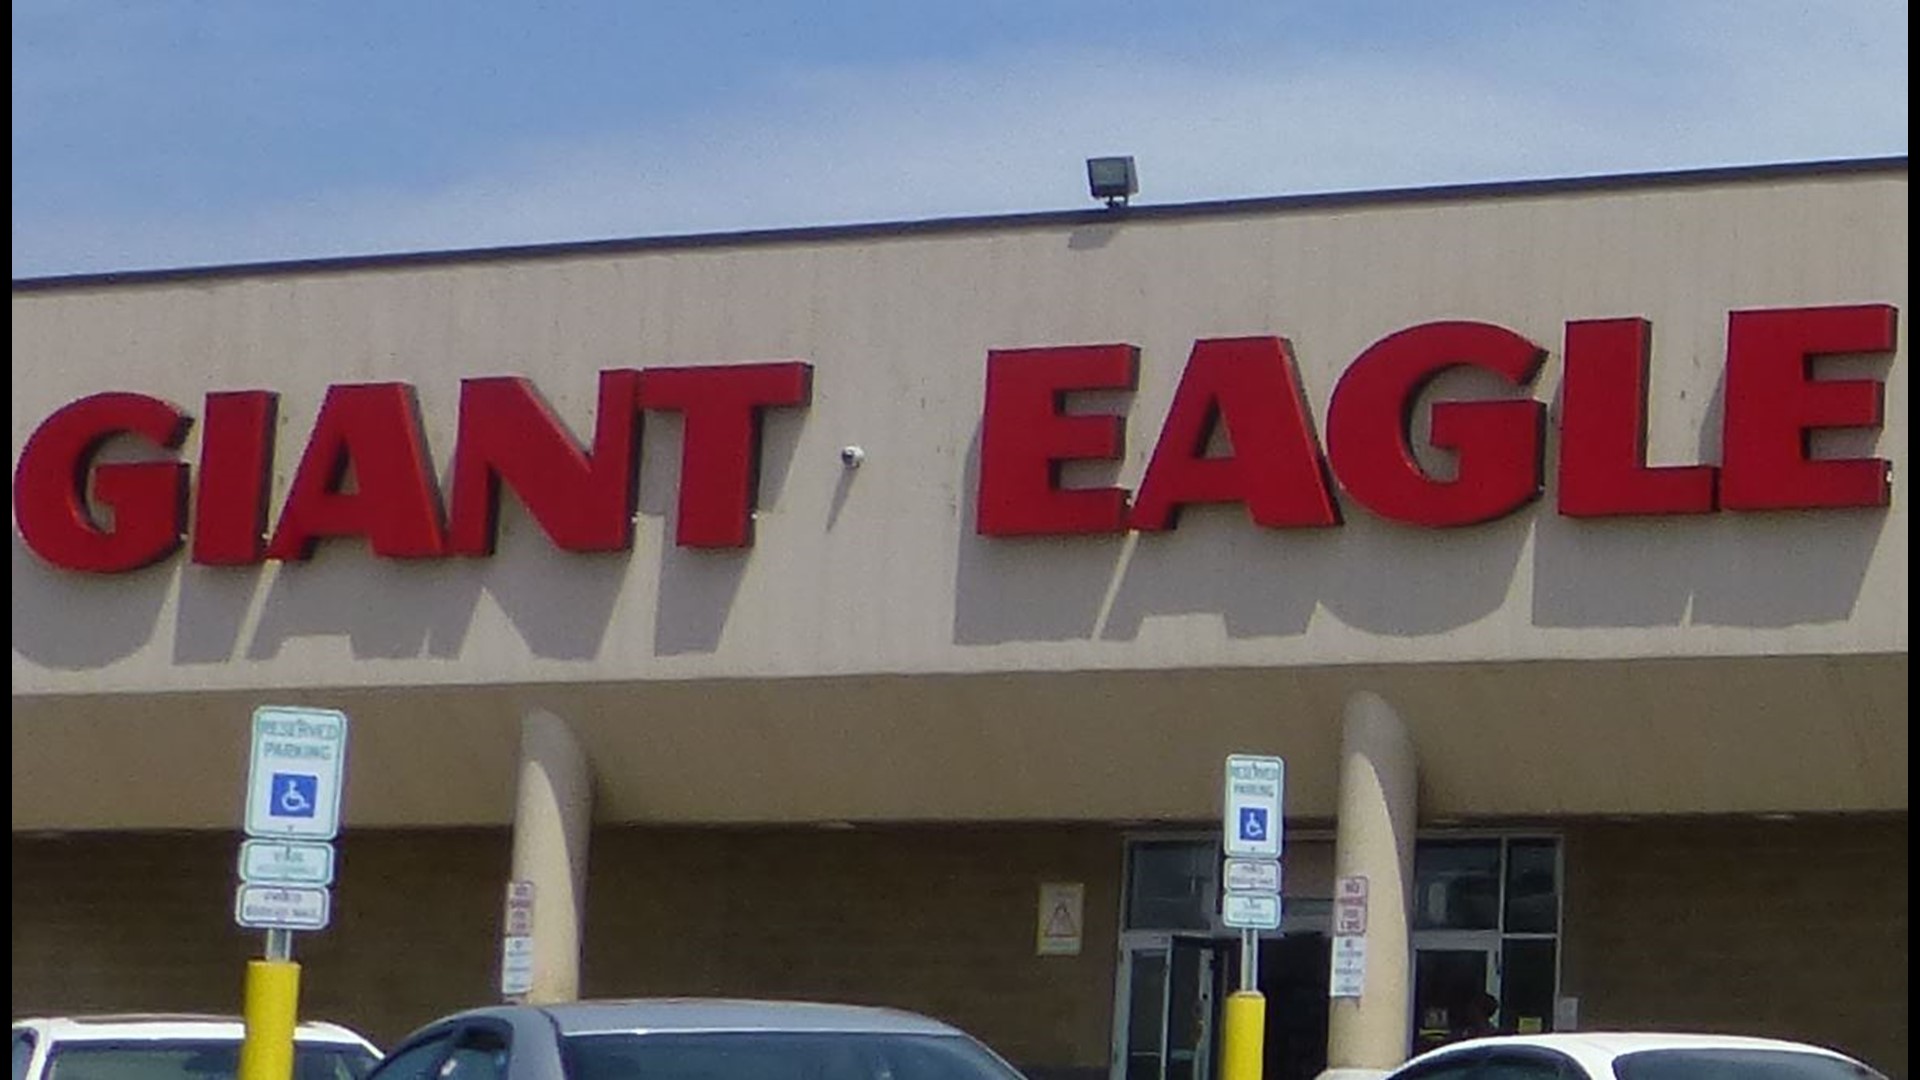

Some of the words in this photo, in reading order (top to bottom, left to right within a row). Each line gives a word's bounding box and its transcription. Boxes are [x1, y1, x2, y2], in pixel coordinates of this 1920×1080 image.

[13, 361, 814, 573] GIANT
[977, 303, 1898, 537] EAGLE
[259, 720, 338, 740] RESERVED
[263, 741, 332, 760] PARKING
[1234, 783, 1275, 798] PARKING
